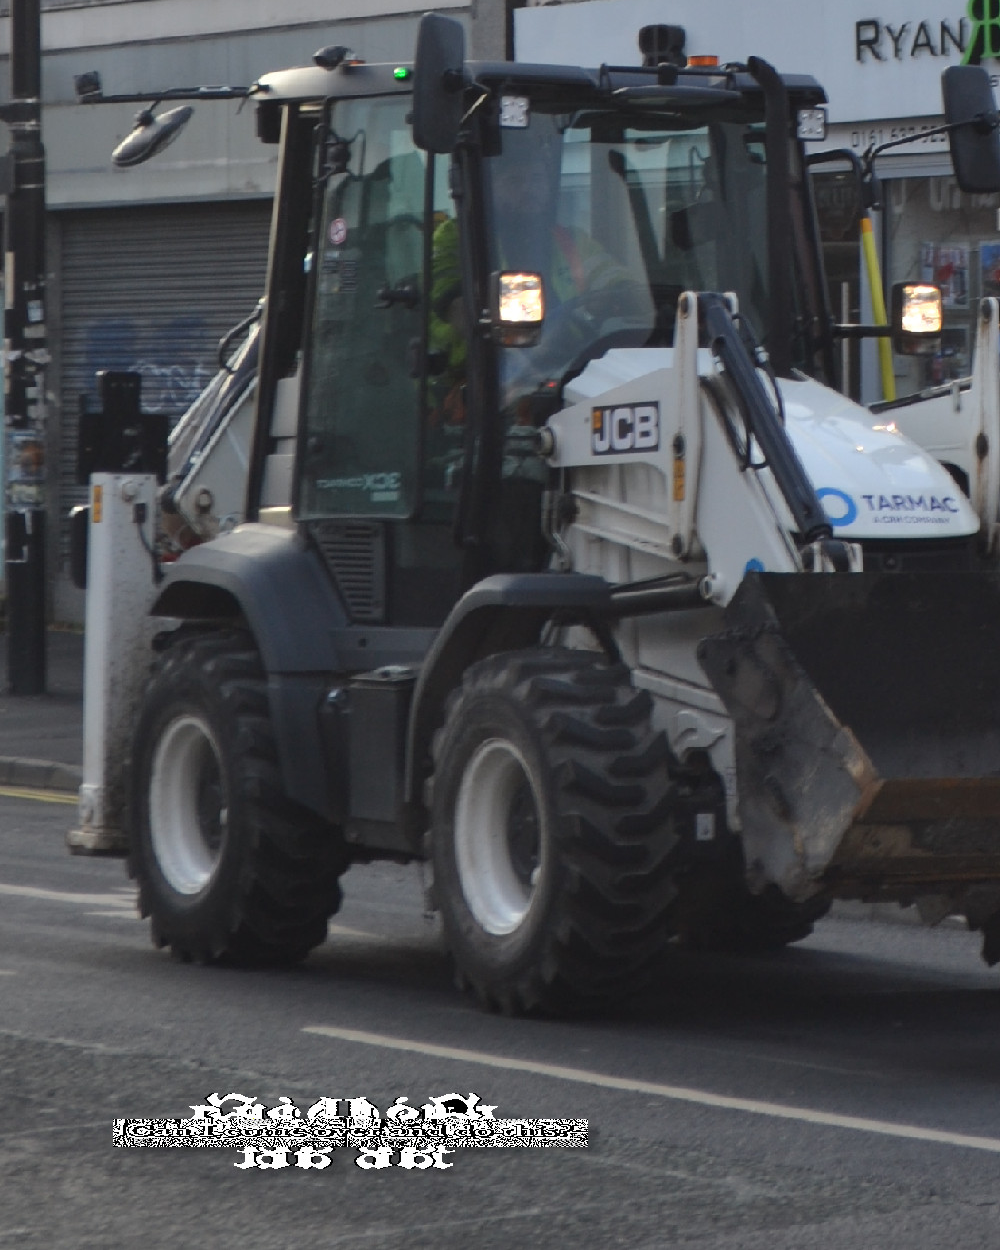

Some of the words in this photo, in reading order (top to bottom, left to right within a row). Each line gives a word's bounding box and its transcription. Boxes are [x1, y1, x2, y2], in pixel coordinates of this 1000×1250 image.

[855, 16, 968, 63] RYAN
[592, 405, 659, 452] JCB
[861, 494, 960, 513] TARMAC
